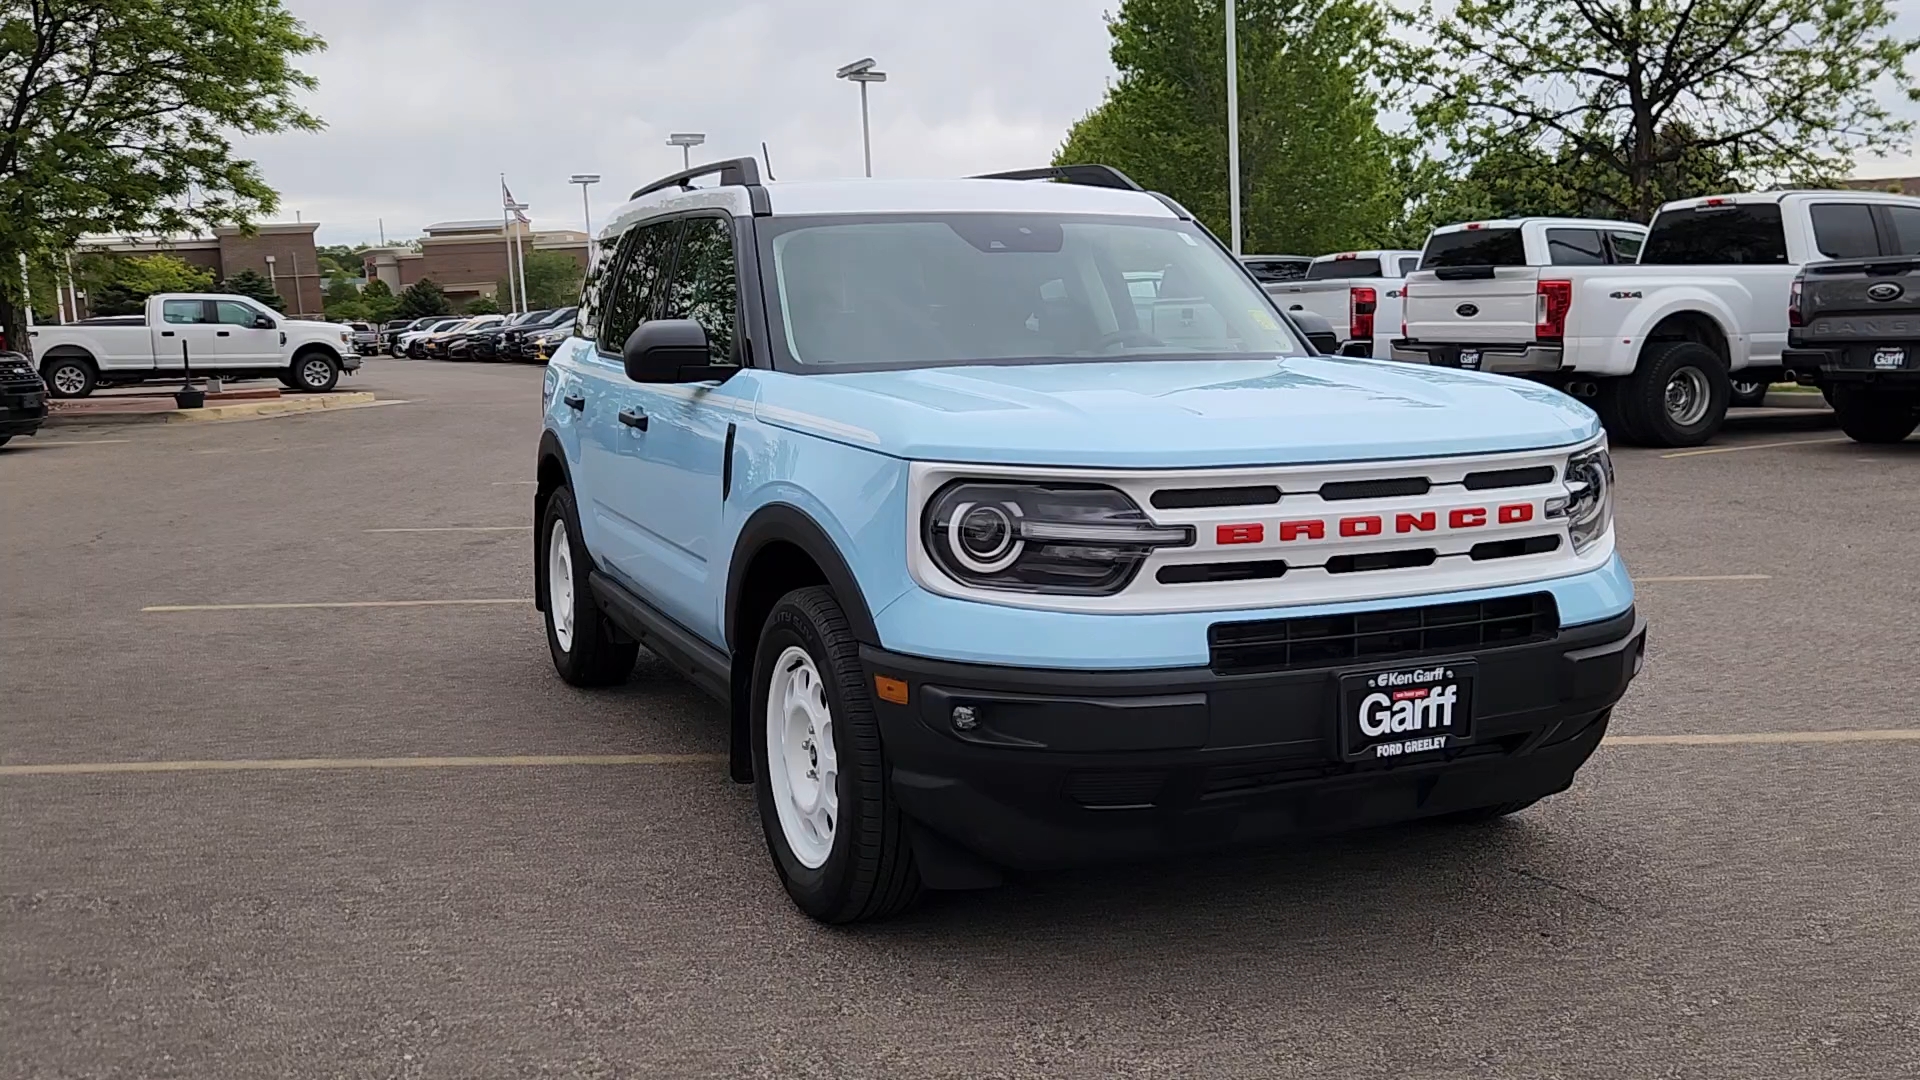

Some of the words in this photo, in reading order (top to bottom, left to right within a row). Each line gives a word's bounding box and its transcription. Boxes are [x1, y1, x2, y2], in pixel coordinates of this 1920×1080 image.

[1874, 352, 1904, 365] Garff
[1216, 503, 1533, 545] BRONCO
[1388, 672, 1412, 685] Ken
[1413, 667, 1444, 683] Garff
[1359, 685, 1457, 736] Garff
[1377, 743, 1403, 757] FORD
[1404, 736, 1446, 753] GREELEY
